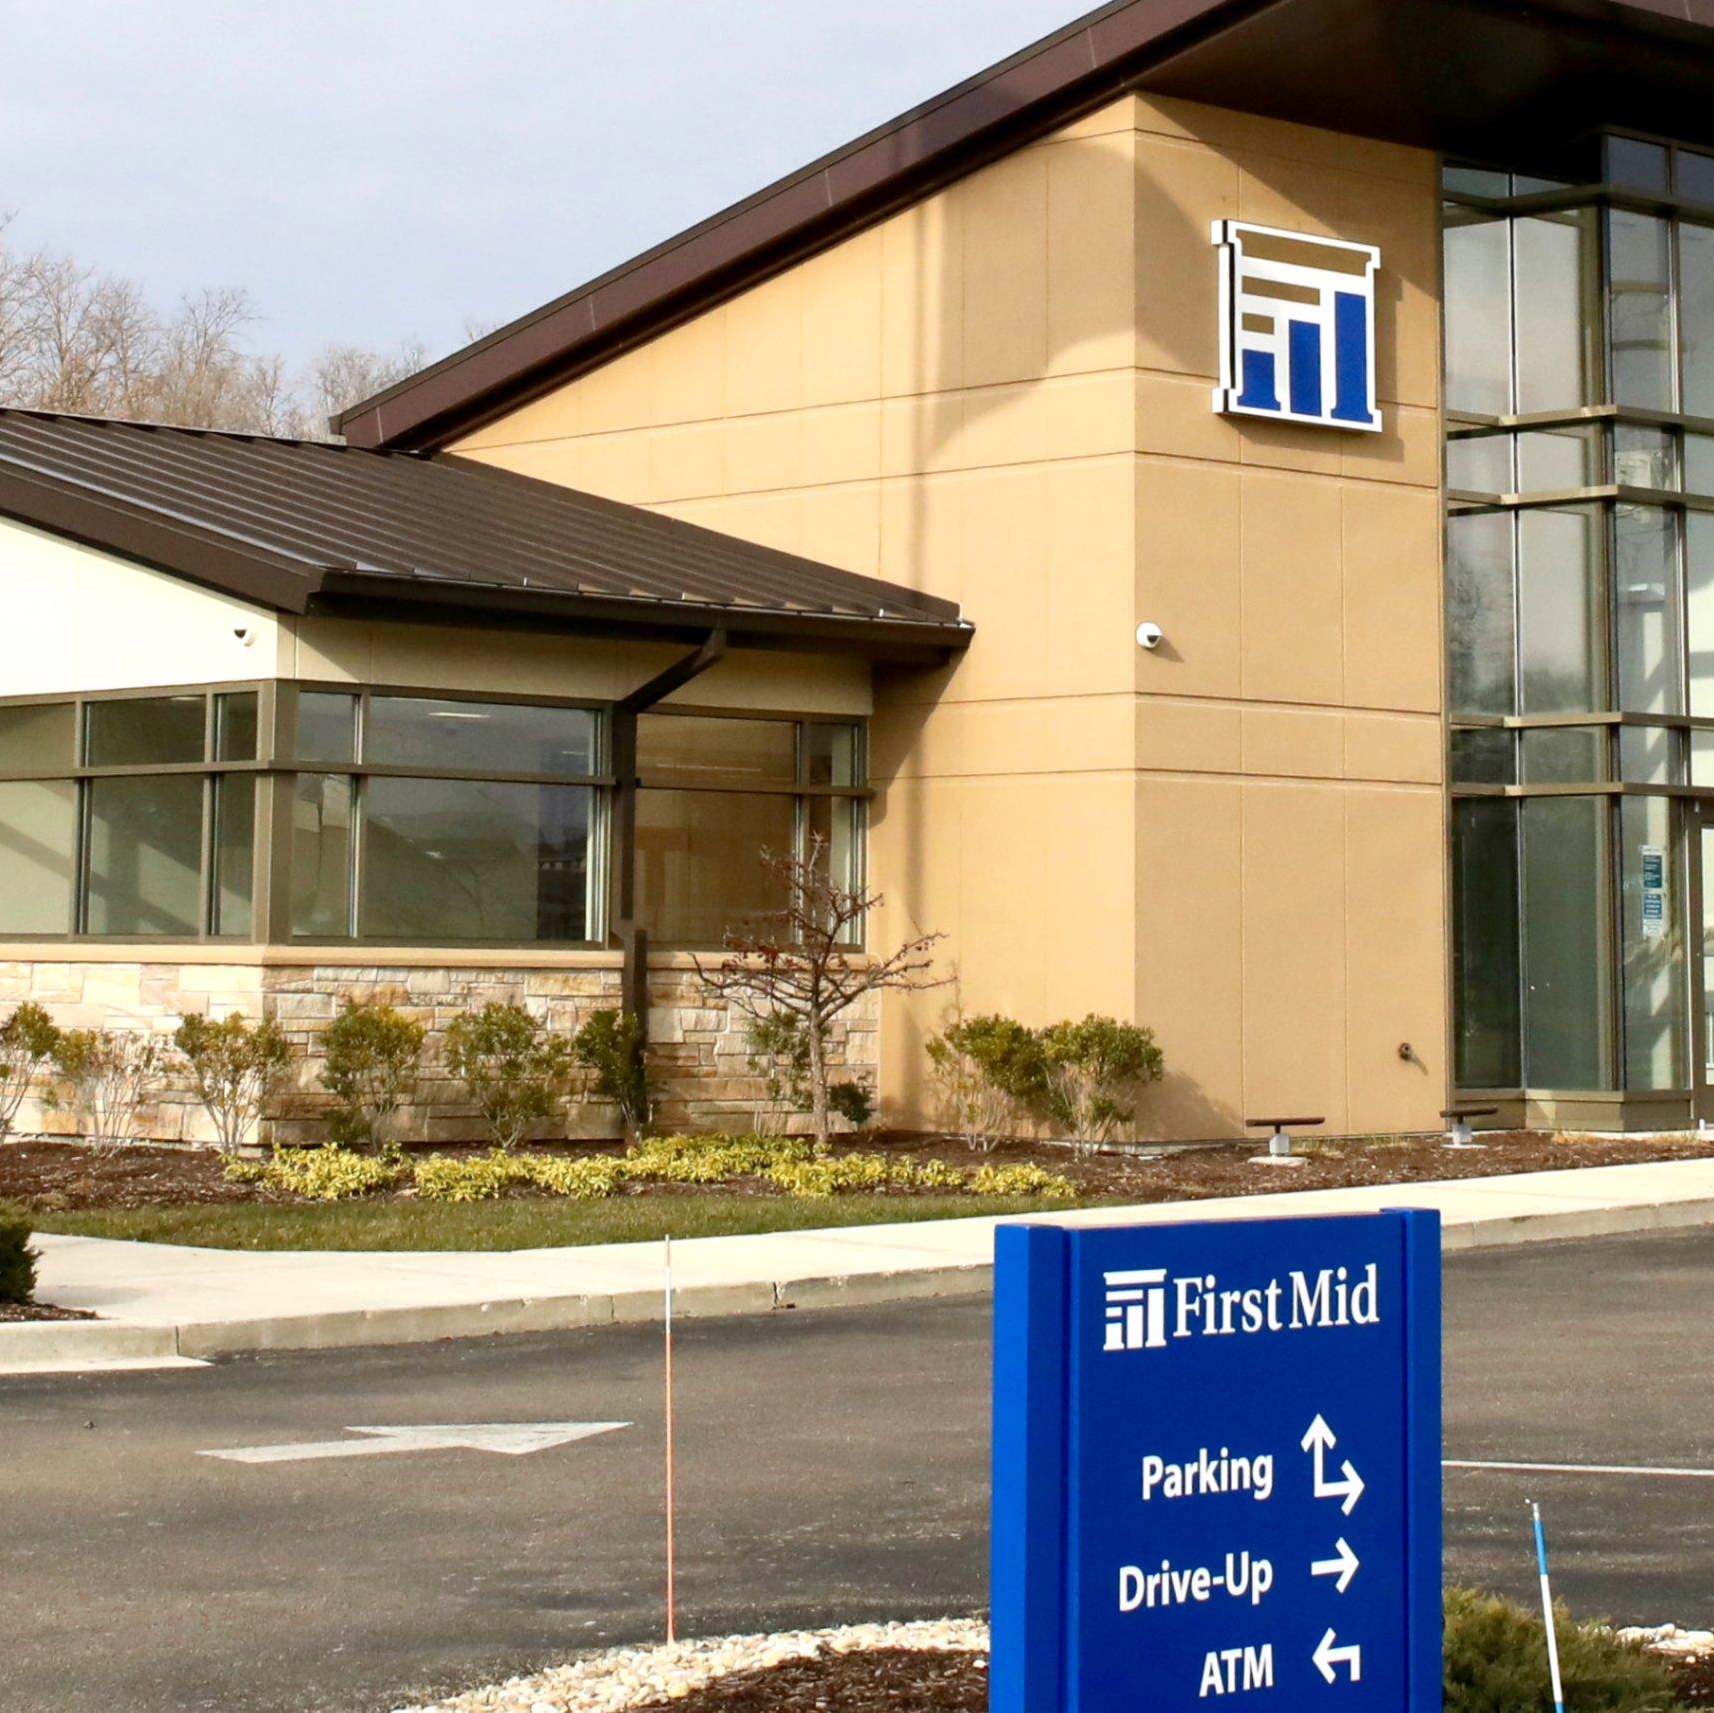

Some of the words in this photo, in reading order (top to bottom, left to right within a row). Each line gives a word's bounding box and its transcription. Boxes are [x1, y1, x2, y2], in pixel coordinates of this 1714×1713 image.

[1172, 1273, 1283, 1338] First
[1289, 1263, 1380, 1329] Mid
[1142, 1447, 1274, 1500] Parking
[1118, 1551, 1274, 1612] Drive-Up
[1198, 1643, 1275, 1698] ATM
